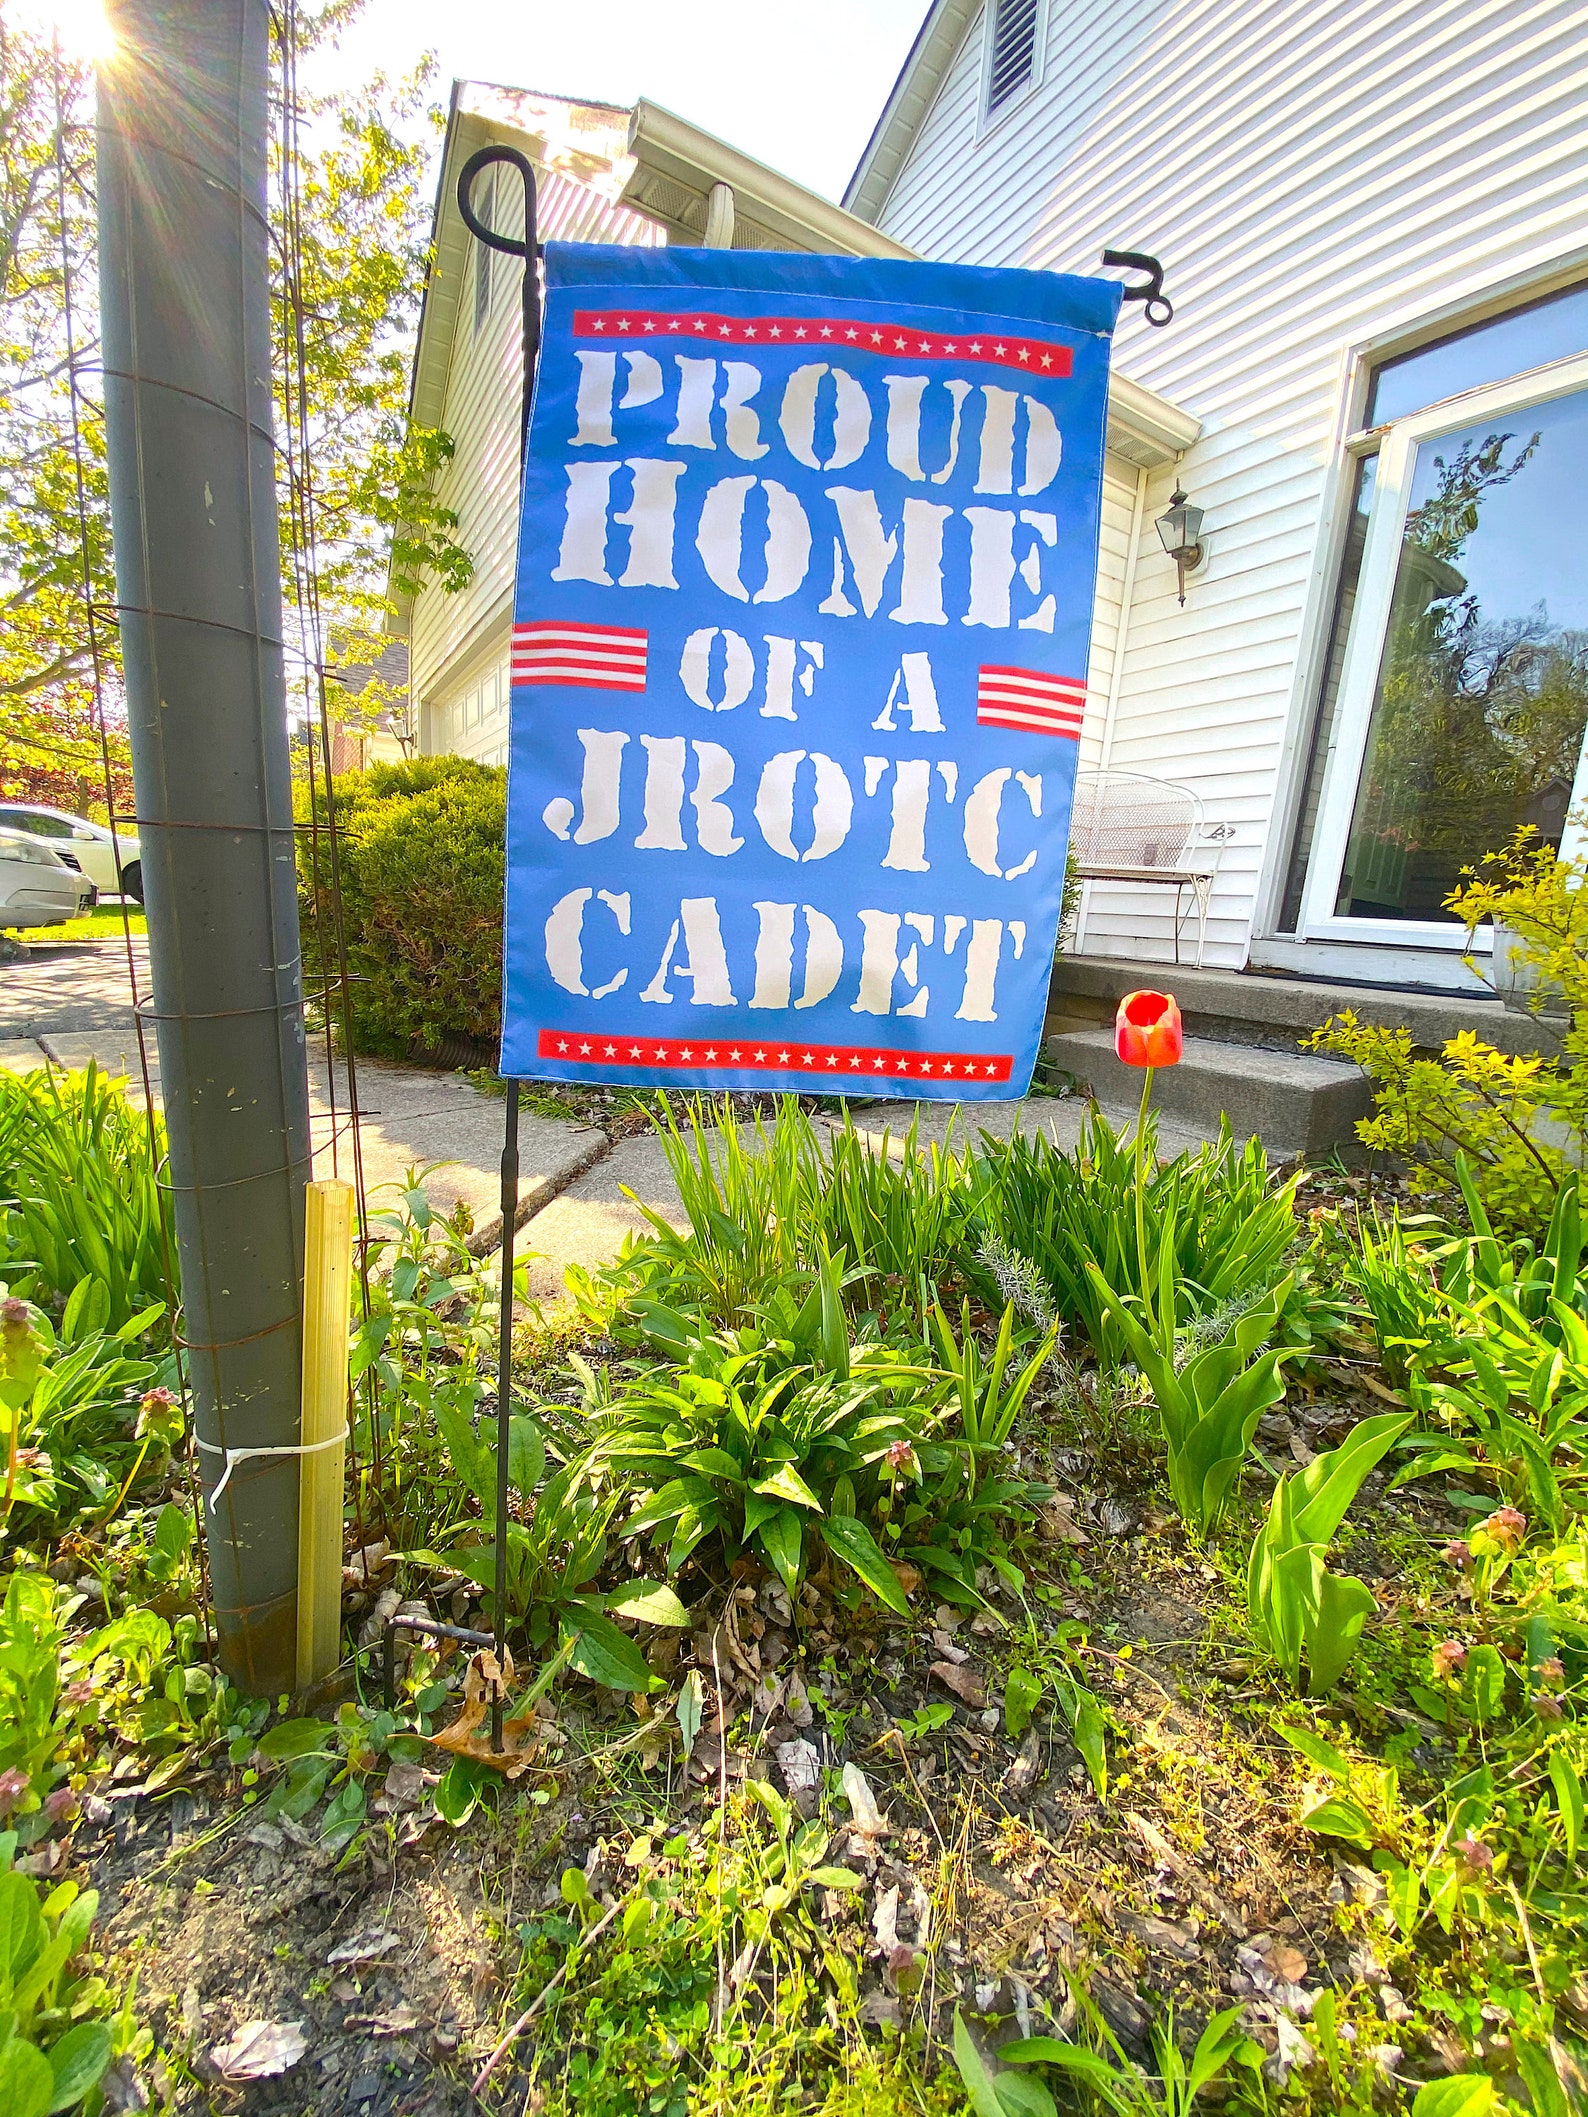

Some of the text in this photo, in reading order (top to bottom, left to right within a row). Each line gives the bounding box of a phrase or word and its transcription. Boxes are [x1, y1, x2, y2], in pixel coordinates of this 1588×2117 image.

[568, 349, 1063, 497] PROUD
[550, 457, 1059, 634] HOME
[678, 626, 948, 733] OF A
[541, 727, 1044, 882] JROTC
[543, 887, 1027, 1023] CADET
